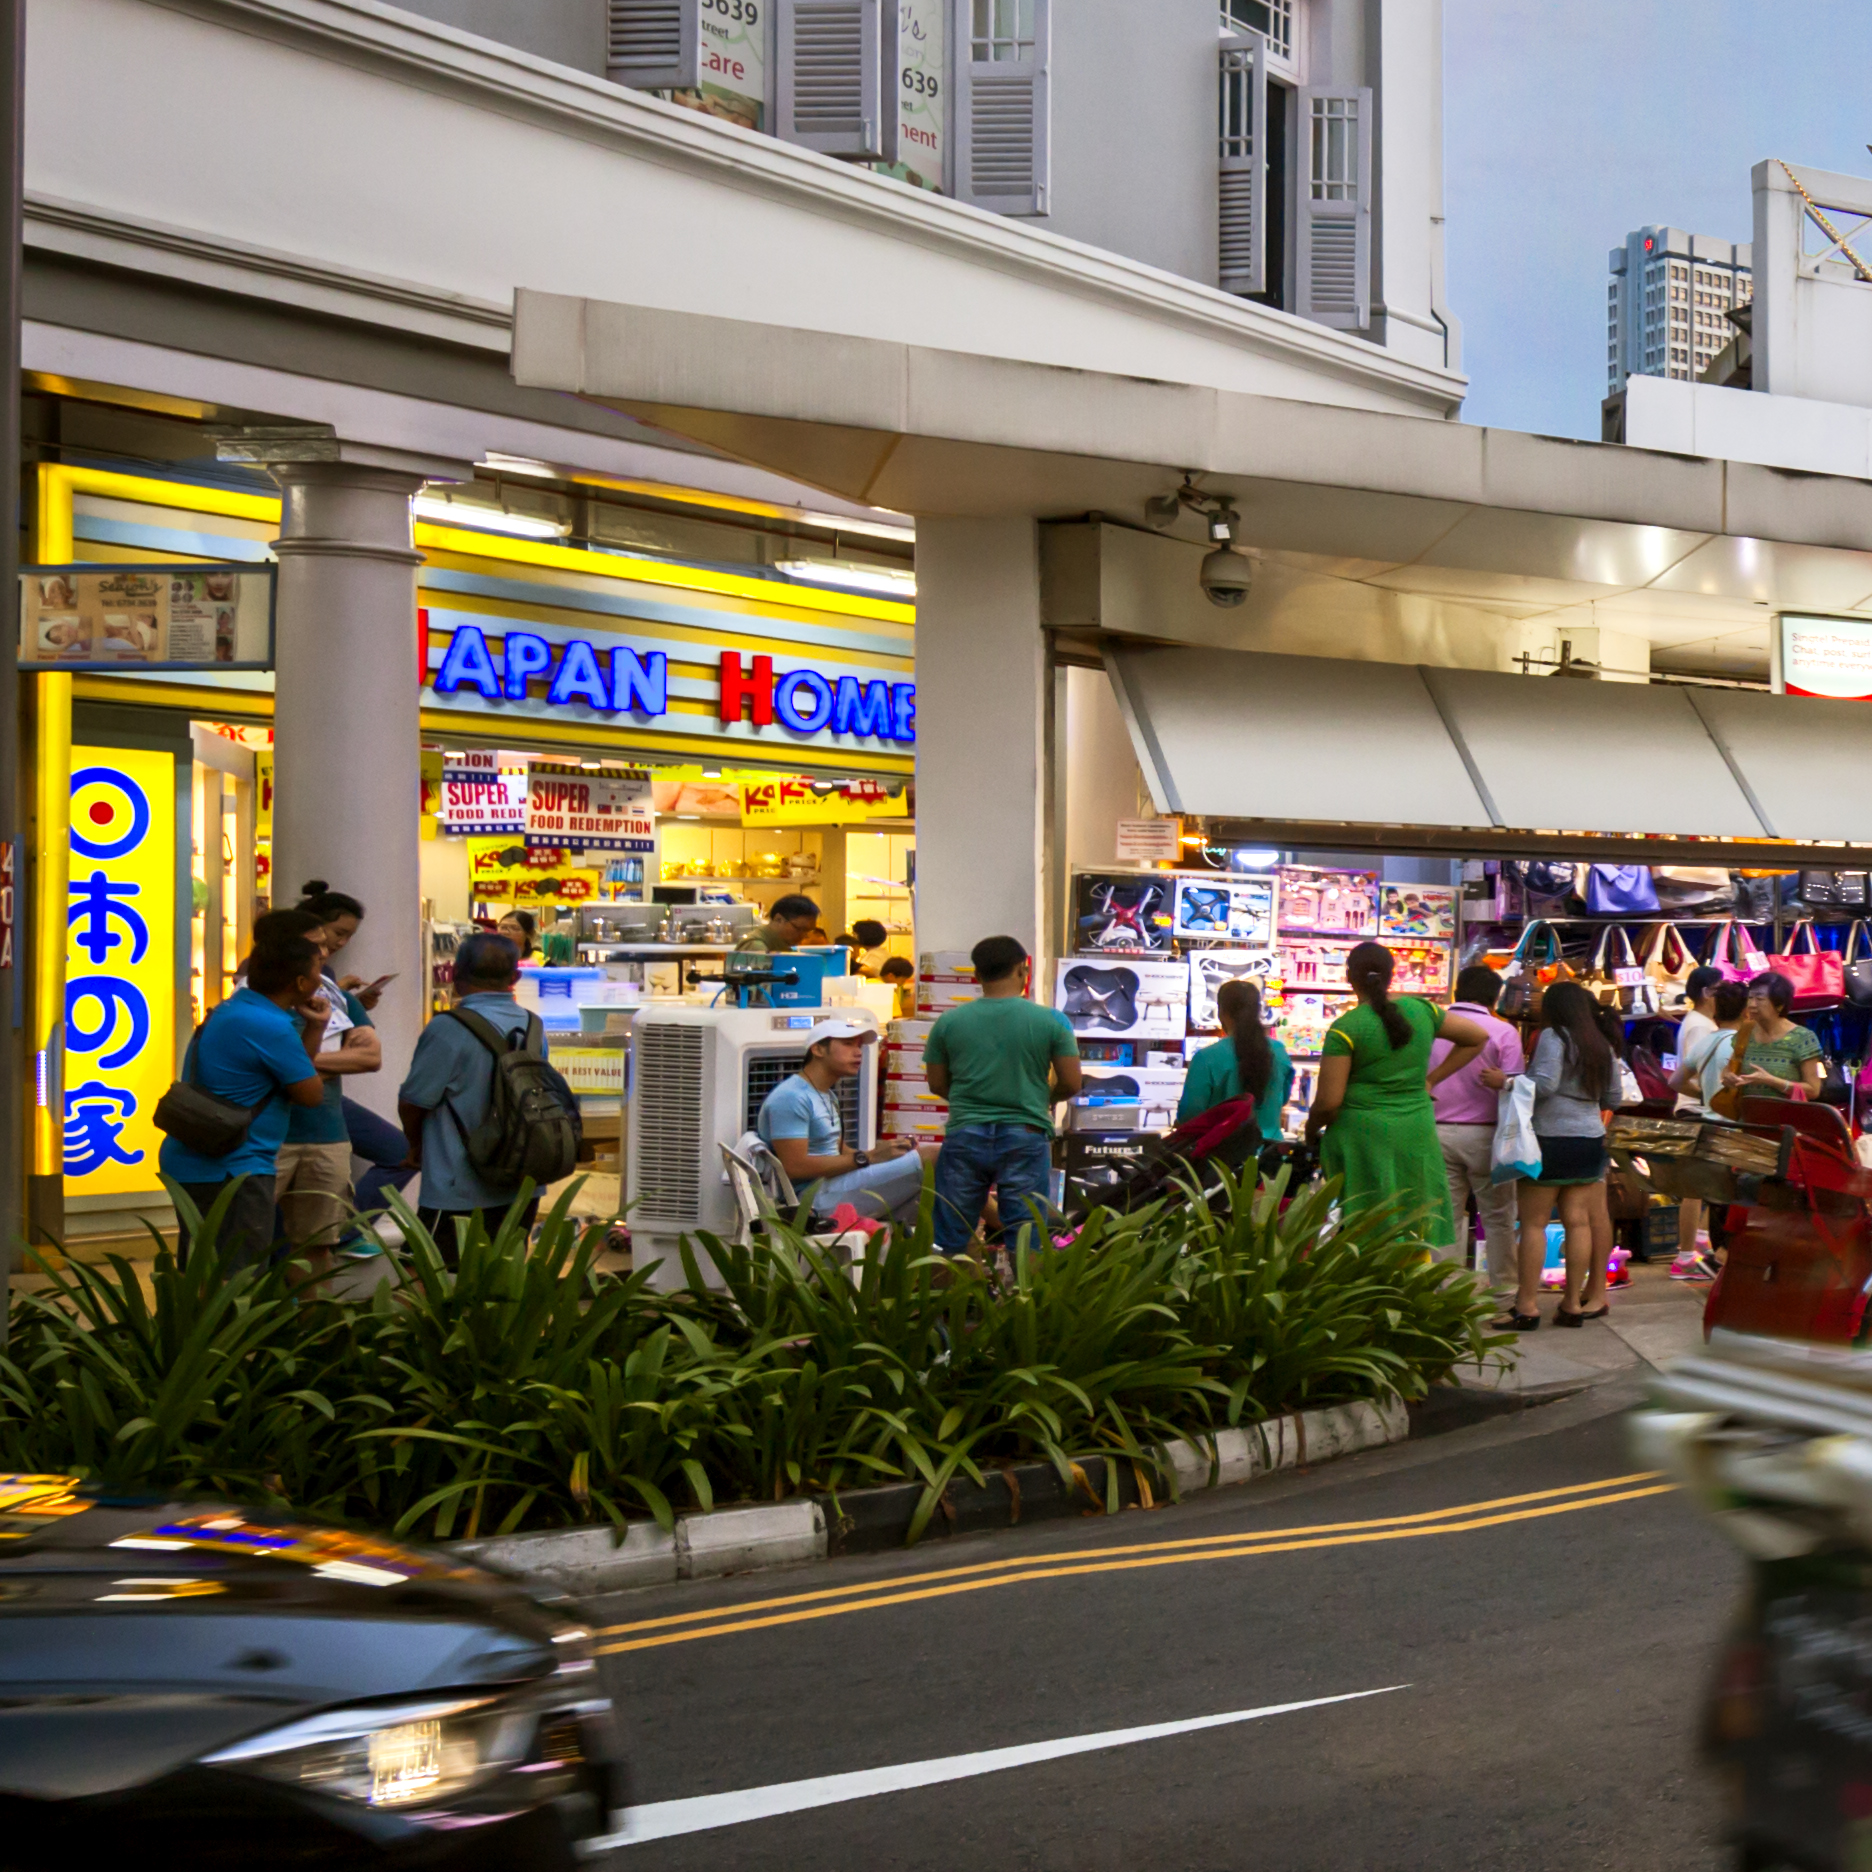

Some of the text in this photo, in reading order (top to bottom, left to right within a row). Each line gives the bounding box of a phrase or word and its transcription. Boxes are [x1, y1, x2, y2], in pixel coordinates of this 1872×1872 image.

[720, 651, 916, 741] HOME
[447, 782, 509, 805] SUPER
[532, 780, 590, 814] SUPER
[448, 809, 484, 820] FOOD
[530, 814, 651, 834] FOOD REDEMPTION
[1616, 970, 1642, 983] $10
[572, 1067, 591, 1076] BEST
[594, 1068, 621, 1077] VALUE
